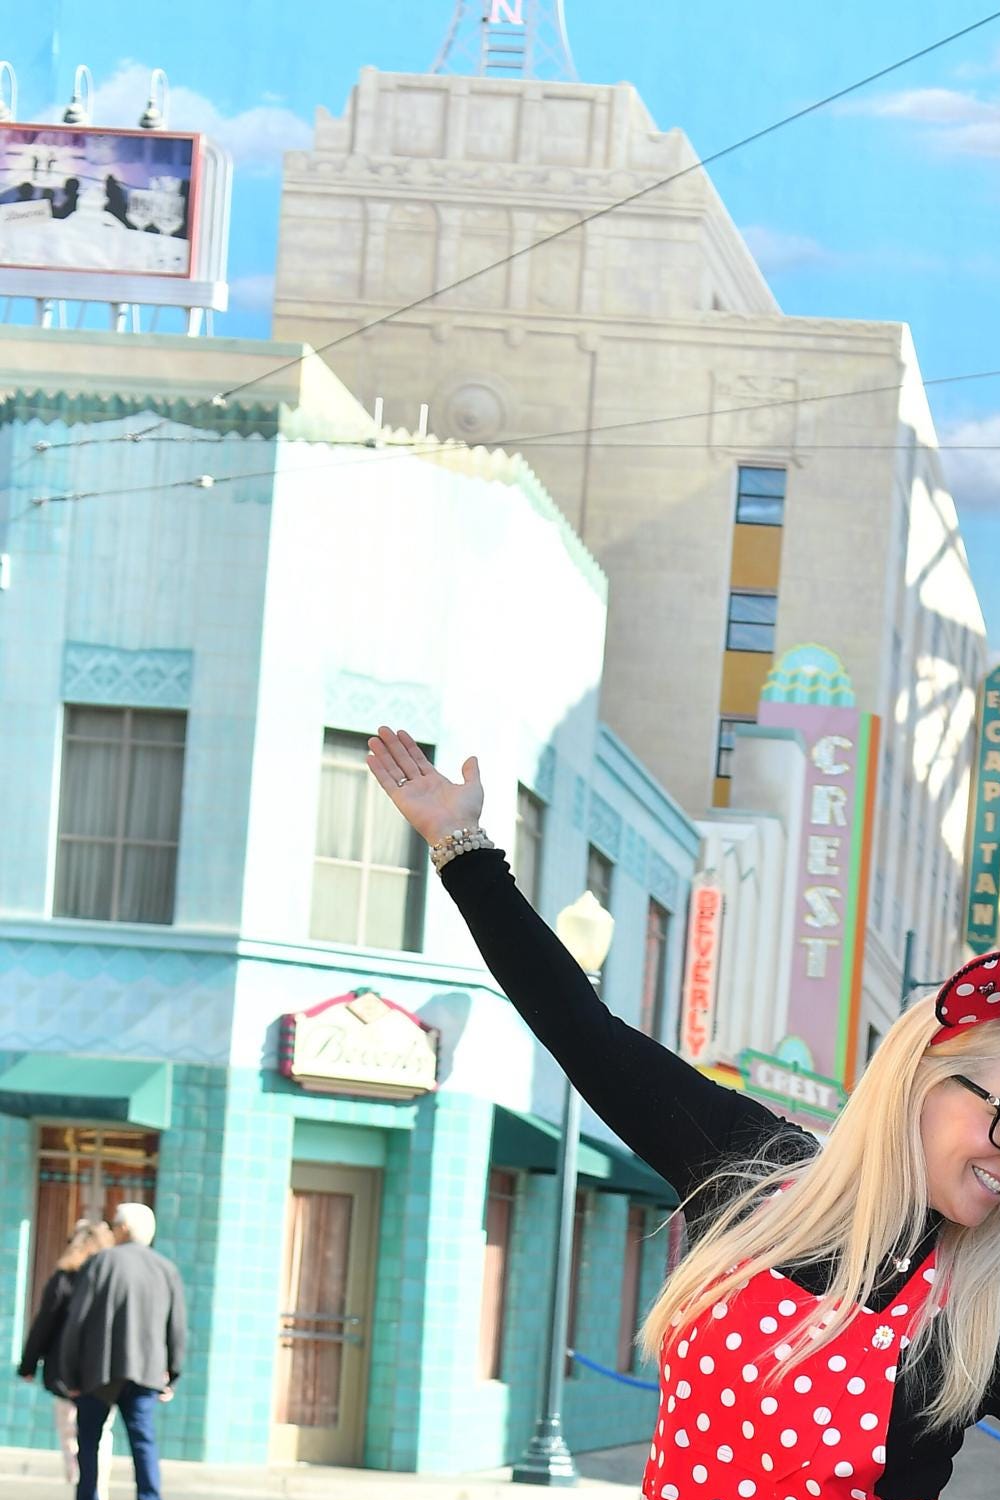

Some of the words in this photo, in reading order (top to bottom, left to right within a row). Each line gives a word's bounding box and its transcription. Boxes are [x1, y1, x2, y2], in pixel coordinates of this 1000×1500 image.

[799, 735, 853, 979] CREST
[687, 889, 718, 1057] BEVERLY
[756, 1064, 832, 1108] CREST
